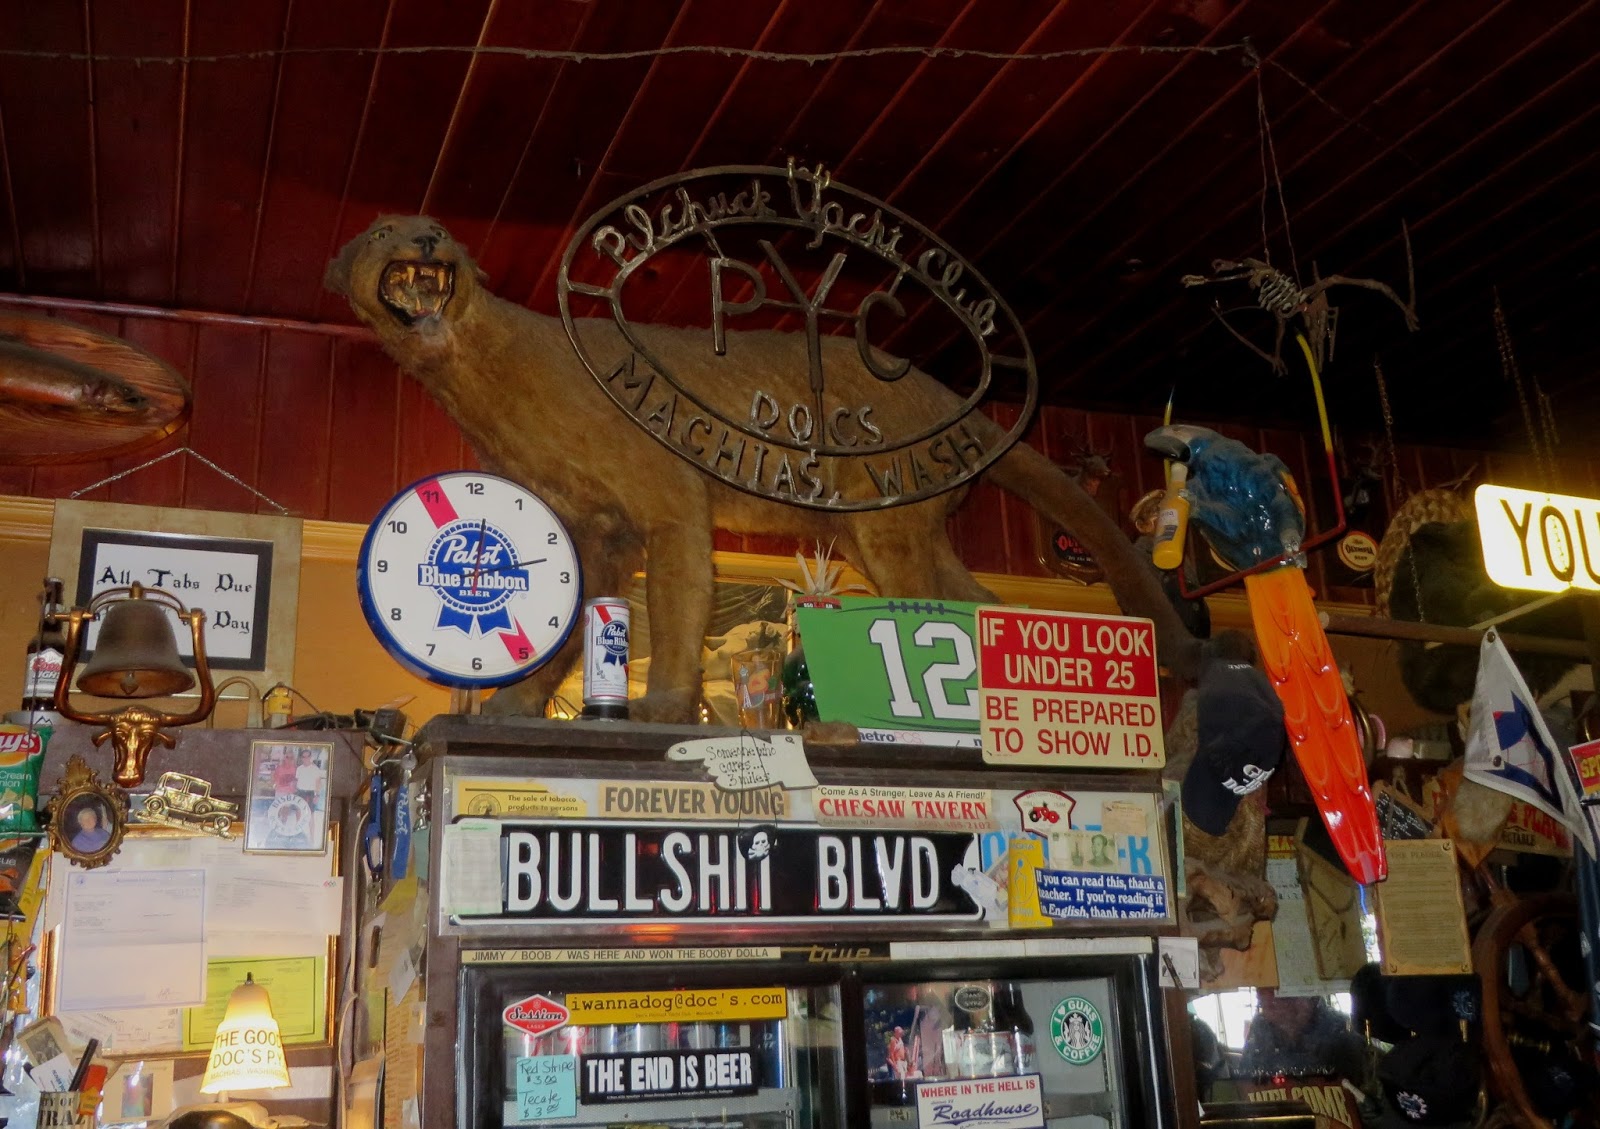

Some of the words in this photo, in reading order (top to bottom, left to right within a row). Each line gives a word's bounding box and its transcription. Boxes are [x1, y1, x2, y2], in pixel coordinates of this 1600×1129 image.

[749, 390, 884, 448] DOCS
[864, 423, 986, 499] WASH
[422, 490, 440, 504] 11
[465, 482, 485, 495] 12
[514, 498, 524, 511] 1
[387, 520, 408, 535] 10
[547, 533, 558, 545] 2
[443, 534, 503, 565] Pabst
[377, 560, 388, 573] 9
[96, 565, 131, 585] All
[146, 568, 200, 588] Tabs
[214, 573, 253, 593] Due
[420, 565, 461, 587] Blue
[463, 567, 528, 591] Ribbon
[559, 571, 571, 584] 3
[459, 589, 491, 598] BEER
[212, 610, 250, 634] Day
[390, 607, 402, 621] 8
[548, 616, 560, 629] 4
[606, 624, 626, 637] Pabst
[982, 617, 1004, 647] IF
[1017, 620, 1069, 651] YOU
[1082, 625, 1152, 658] LOOK
[425, 643, 436, 657] 7
[597, 636, 613, 646] Blue
[518, 647, 529, 660] 5
[471, 657, 483, 671] 6
[868, 618, 981, 721] 12
[1004, 654, 1093, 688] UNDER
[1105, 660, 1136, 690] 25
[985, 695, 1020, 722] BE
[1032, 698, 1156, 728] PREPARED
[988, 727, 1024, 755] TO
[1037, 729, 1111, 757] SHOW
[1123, 732, 1159, 758] I.D.
[705, 745, 756, 761] Someone
[727, 773, 738, 786] 3
[508, 794, 523, 802] The
[540, 794, 548, 802] of
[549, 795, 577, 803] tobacco
[604, 786, 708, 815] FOREVER
[709, 788, 786, 816] YOUNG
[849, 788, 859, 796] As
[861, 788, 868, 796] A
[871, 788, 907, 798] Stranger,
[909, 789, 933, 798] Leave
[935, 790, 946, 798] As
[947, 790, 954, 798] A
[508, 803, 539, 812] products
[549, 804, 579, 813] persons
[818, 798, 905, 818] CHESAW
[912, 800, 988, 820] TAVERN
[817, 835, 940, 912] BLVD
[1036, 869, 1044, 883] If
[1043, 874, 1060, 888] you
[1061, 875, 1080, 887] can
[1081, 875, 1104, 887] read
[1106, 874, 1127, 890] this,
[1128, 876, 1156, 890] thank
[1156, 881, 1164, 890] a
[1038, 888, 1071, 900] teacher.
[1075, 888, 1085, 901] If
[1086, 890, 1116, 905] you're
[1118, 892, 1154, 908] reading
[1154, 893, 1163, 905] it
[1048, 903, 1090, 918] English,
[1090, 905, 1119, 918] thank
[1120, 909, 1128, 918] a
[1129, 907, 1166, 919] soldier
[472, 951, 506, 962] JIMMY
[521, 951, 551, 961] BOOB
[567, 950, 590, 960] WAS
[593, 950, 620, 960] HERE
[623, 950, 646, 960] AND
[649, 949, 674, 960] WON
[676, 949, 696, 959] THE
[699, 948, 733, 959] BOOBY
[736, 948, 769, 958] DOLLA
[808, 944, 871, 962] true
[571, 992, 783, 1012] iwannadog@doc's.com
[1067, 999, 1097, 1022] GUNS
[509, 1006, 565, 1021] Session
[215, 1030, 240, 1050] THE
[1062, 1034, 1101, 1060] COFFEE
[519, 1059, 539, 1075] Red
[542, 1057, 574, 1073] Stripe
[586, 1059, 625, 1094] THE
[630, 1056, 675, 1091] END
[679, 1055, 699, 1089] IS
[704, 1052, 753, 1087] BEER
[518, 1089, 561, 1106] Tecate
[920, 1085, 958, 1098] WHERE
[960, 1084, 972, 1095] IN
[974, 1082, 995, 1094] THE
[997, 1081, 1023, 1092] HELL
[1026, 1080, 1036, 1090] IS
[932, 1100, 1038, 1121] Roadhouse
